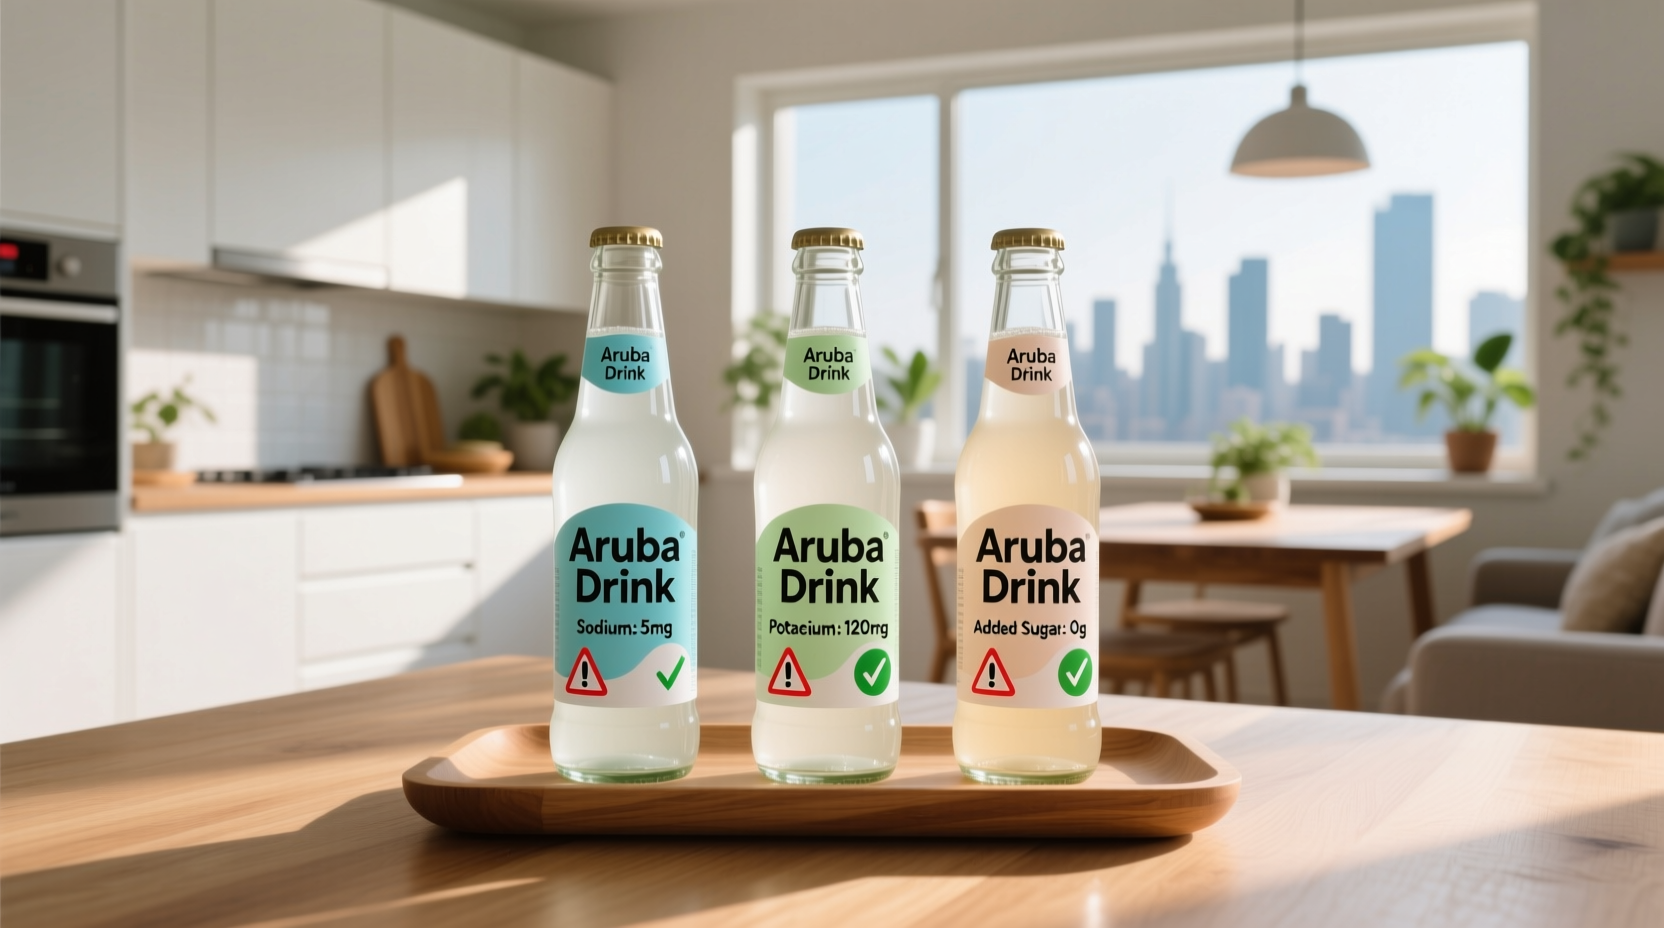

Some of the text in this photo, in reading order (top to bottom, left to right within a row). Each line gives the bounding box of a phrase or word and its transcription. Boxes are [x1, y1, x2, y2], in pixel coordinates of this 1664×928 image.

[601, 347, 649, 362] Aruba
[804, 347, 853, 363] Aruba
[1007, 348, 1055, 364] Aruba
[605, 366, 645, 380] Drink
[809, 365, 849, 380] Drink
[1012, 367, 1051, 381] Drink
[569, 527, 679, 562] Aruba
[773, 528, 883, 563] Aruba
[976, 529, 1085, 563] Aruba
[577, 568, 675, 603] Drink
[782, 568, 879, 603] Drink
[983, 569, 1080, 603] Drink
[577, 619, 672, 638] Sodium: 5mg
[974, 619, 1086, 639] Added Sugar: 0g
